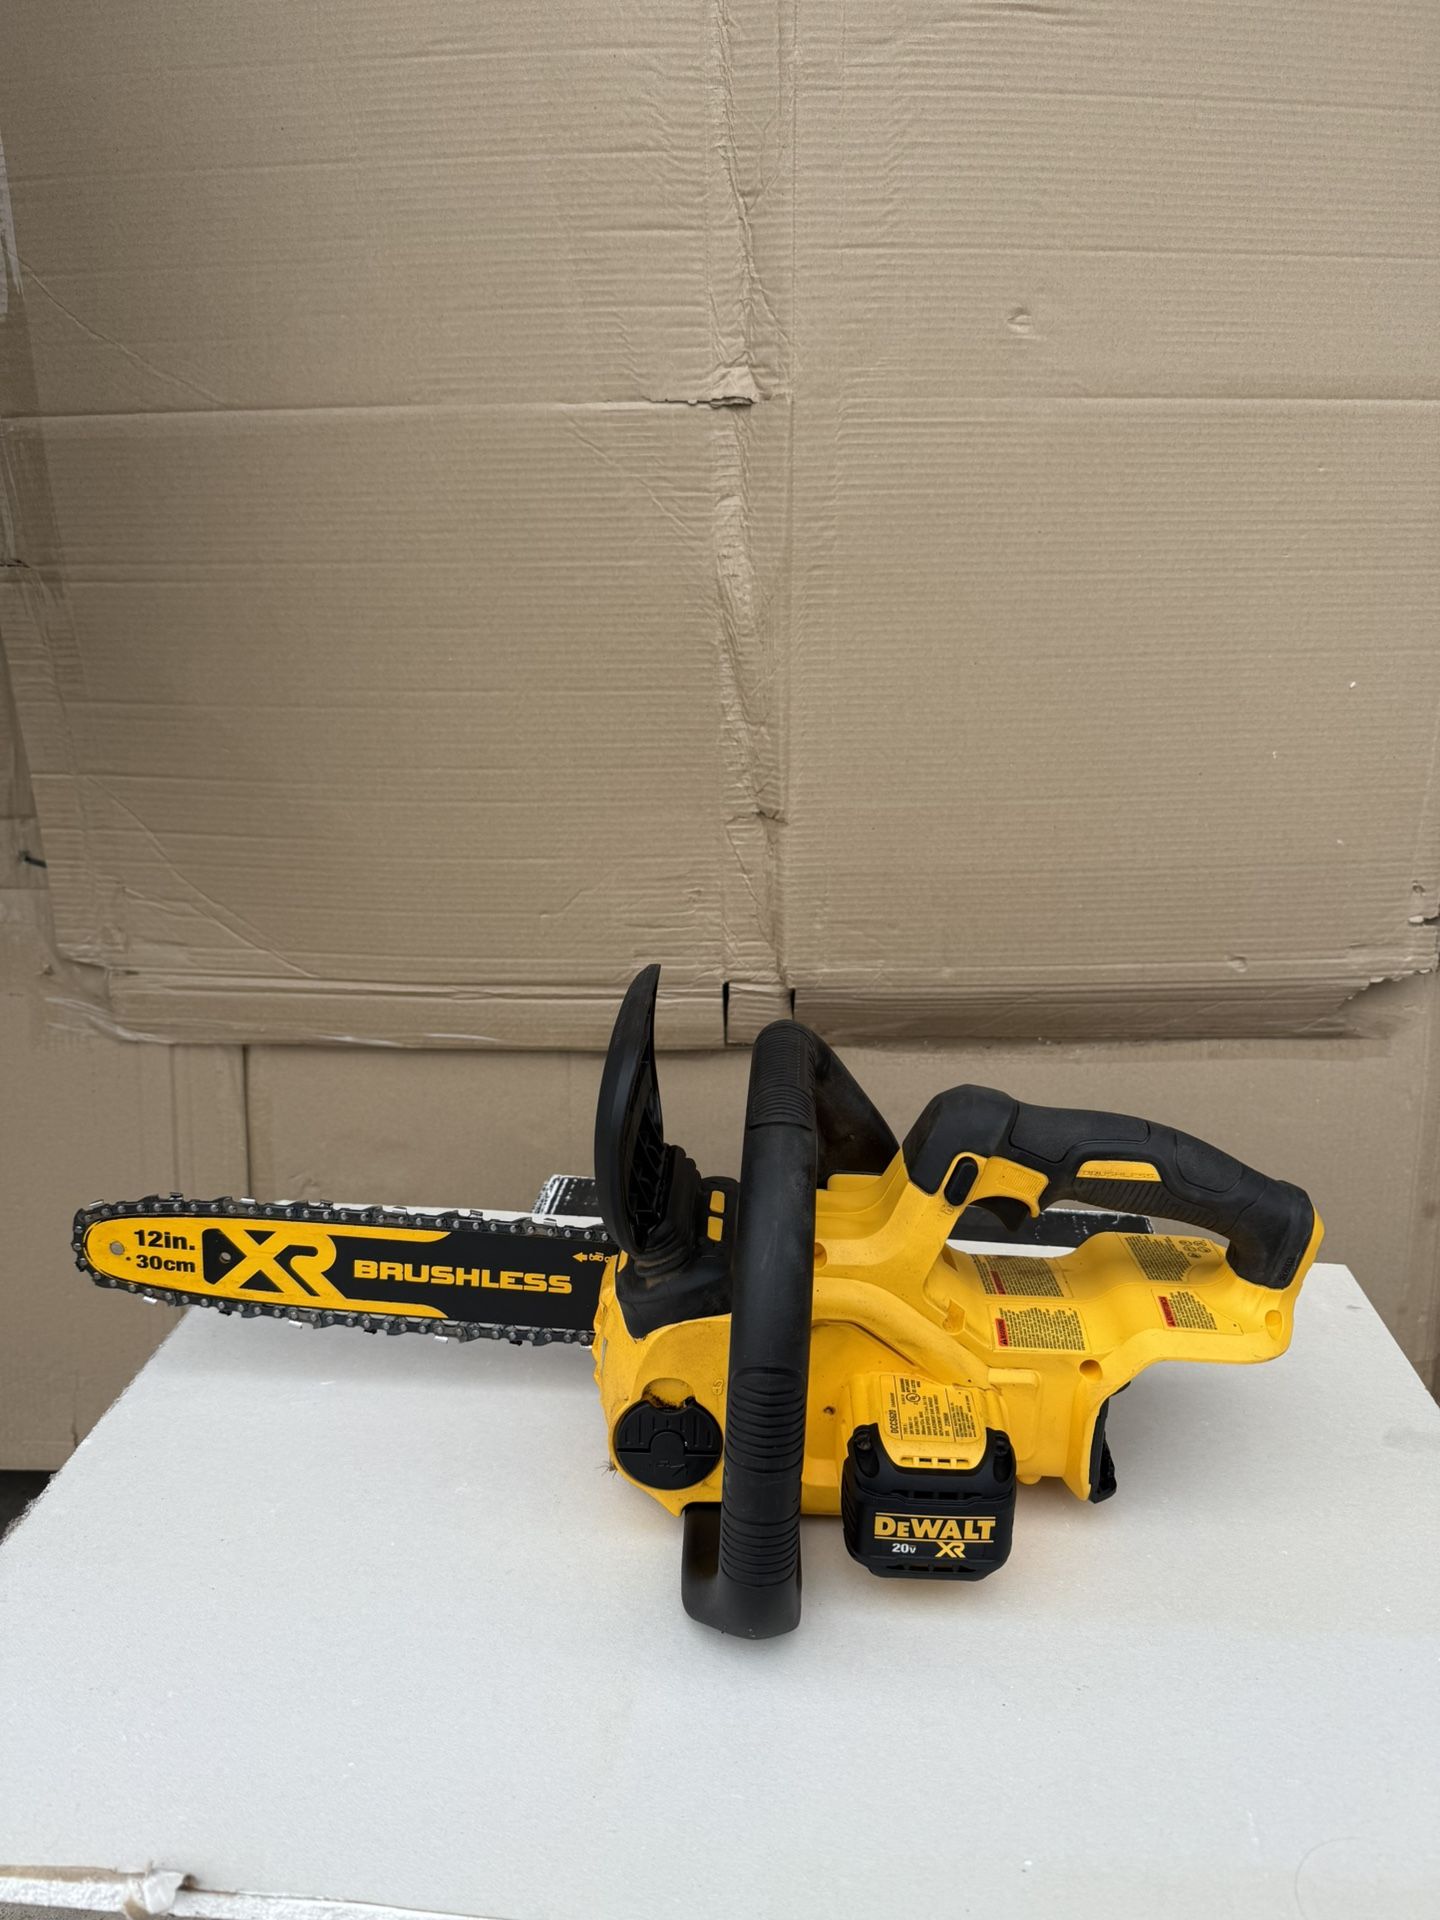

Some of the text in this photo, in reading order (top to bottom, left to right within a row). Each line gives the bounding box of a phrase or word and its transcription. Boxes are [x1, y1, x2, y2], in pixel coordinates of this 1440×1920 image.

[134, 1229, 196, 1251] 12in.
[136, 1254, 196, 1273] 30cm
[213, 1228, 347, 1300] XR
[354, 1259, 573, 1294] BRUSHLESS
[935, 1541, 966, 1559] XR
